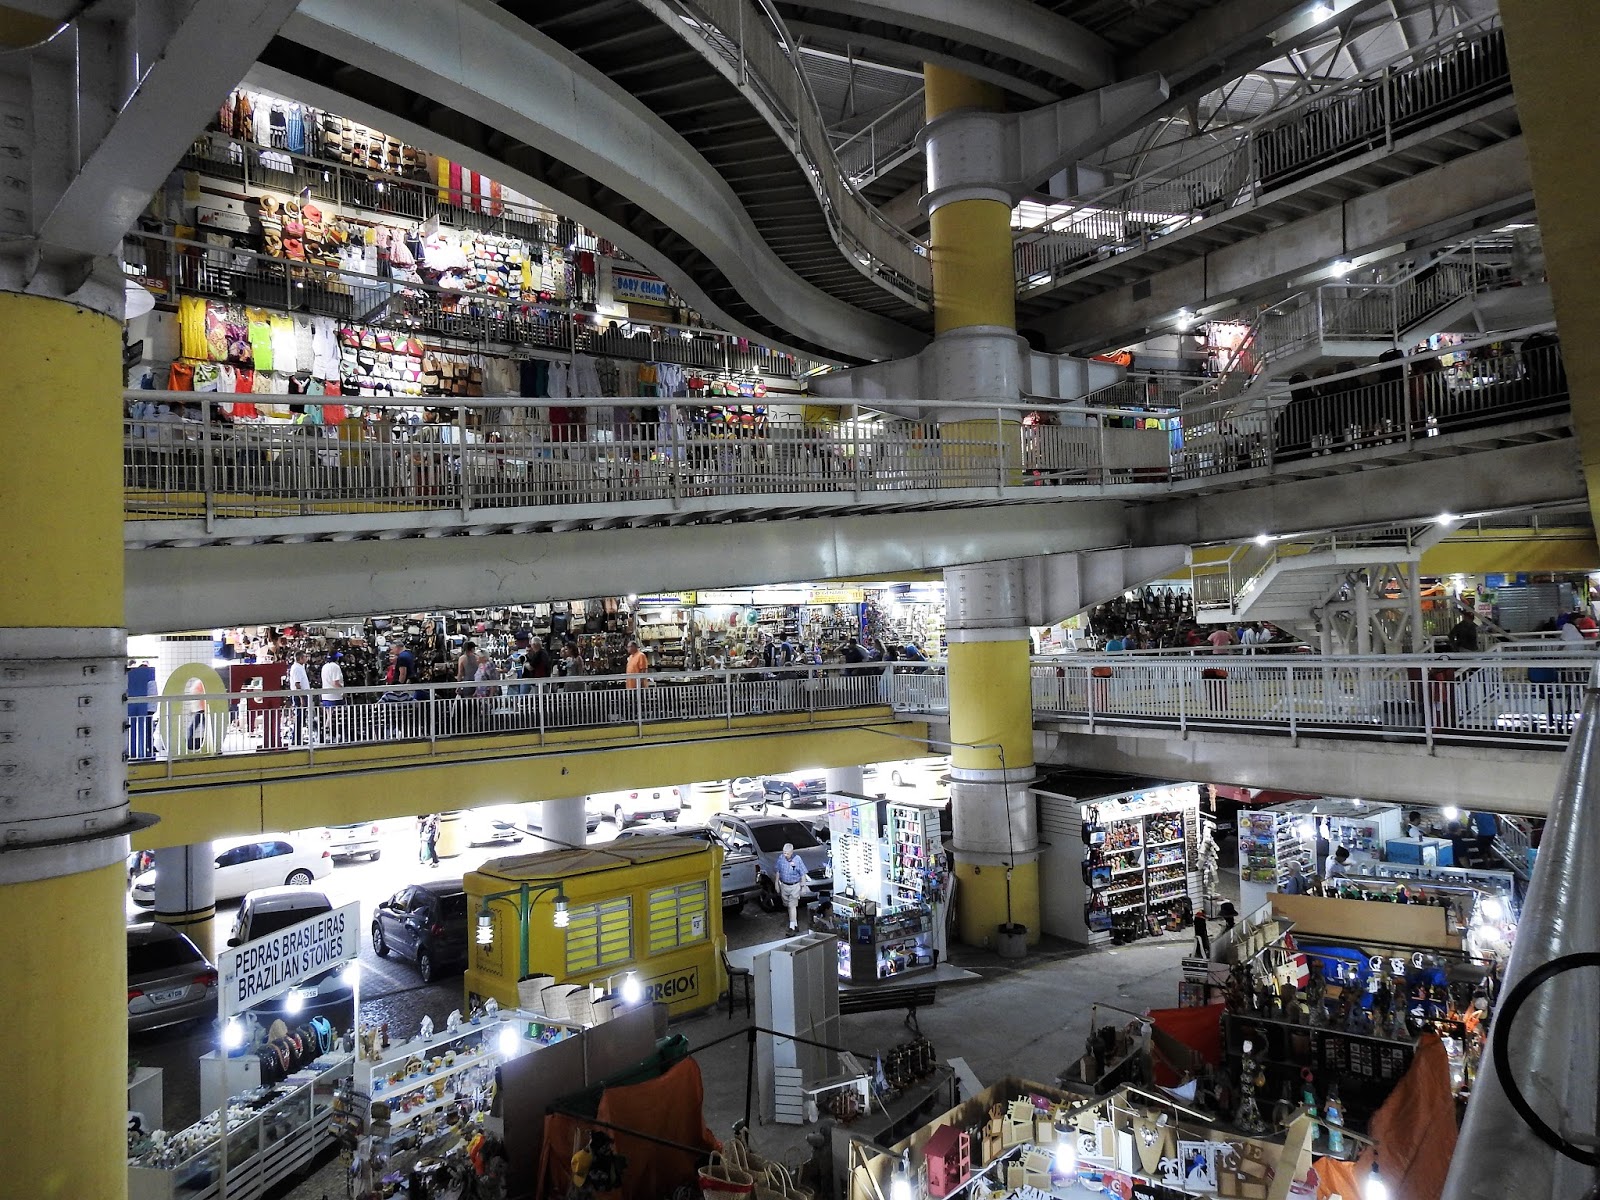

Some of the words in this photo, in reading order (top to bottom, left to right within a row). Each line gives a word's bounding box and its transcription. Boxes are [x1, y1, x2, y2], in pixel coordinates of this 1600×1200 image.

[235, 938, 279, 977] PEDRAS
[282, 912, 345, 958] BRASILEIRAS
[238, 956, 300, 1002] BRAZILIAN
[302, 936, 343, 972] STONES
[616, 973, 695, 1001] RREIOS
